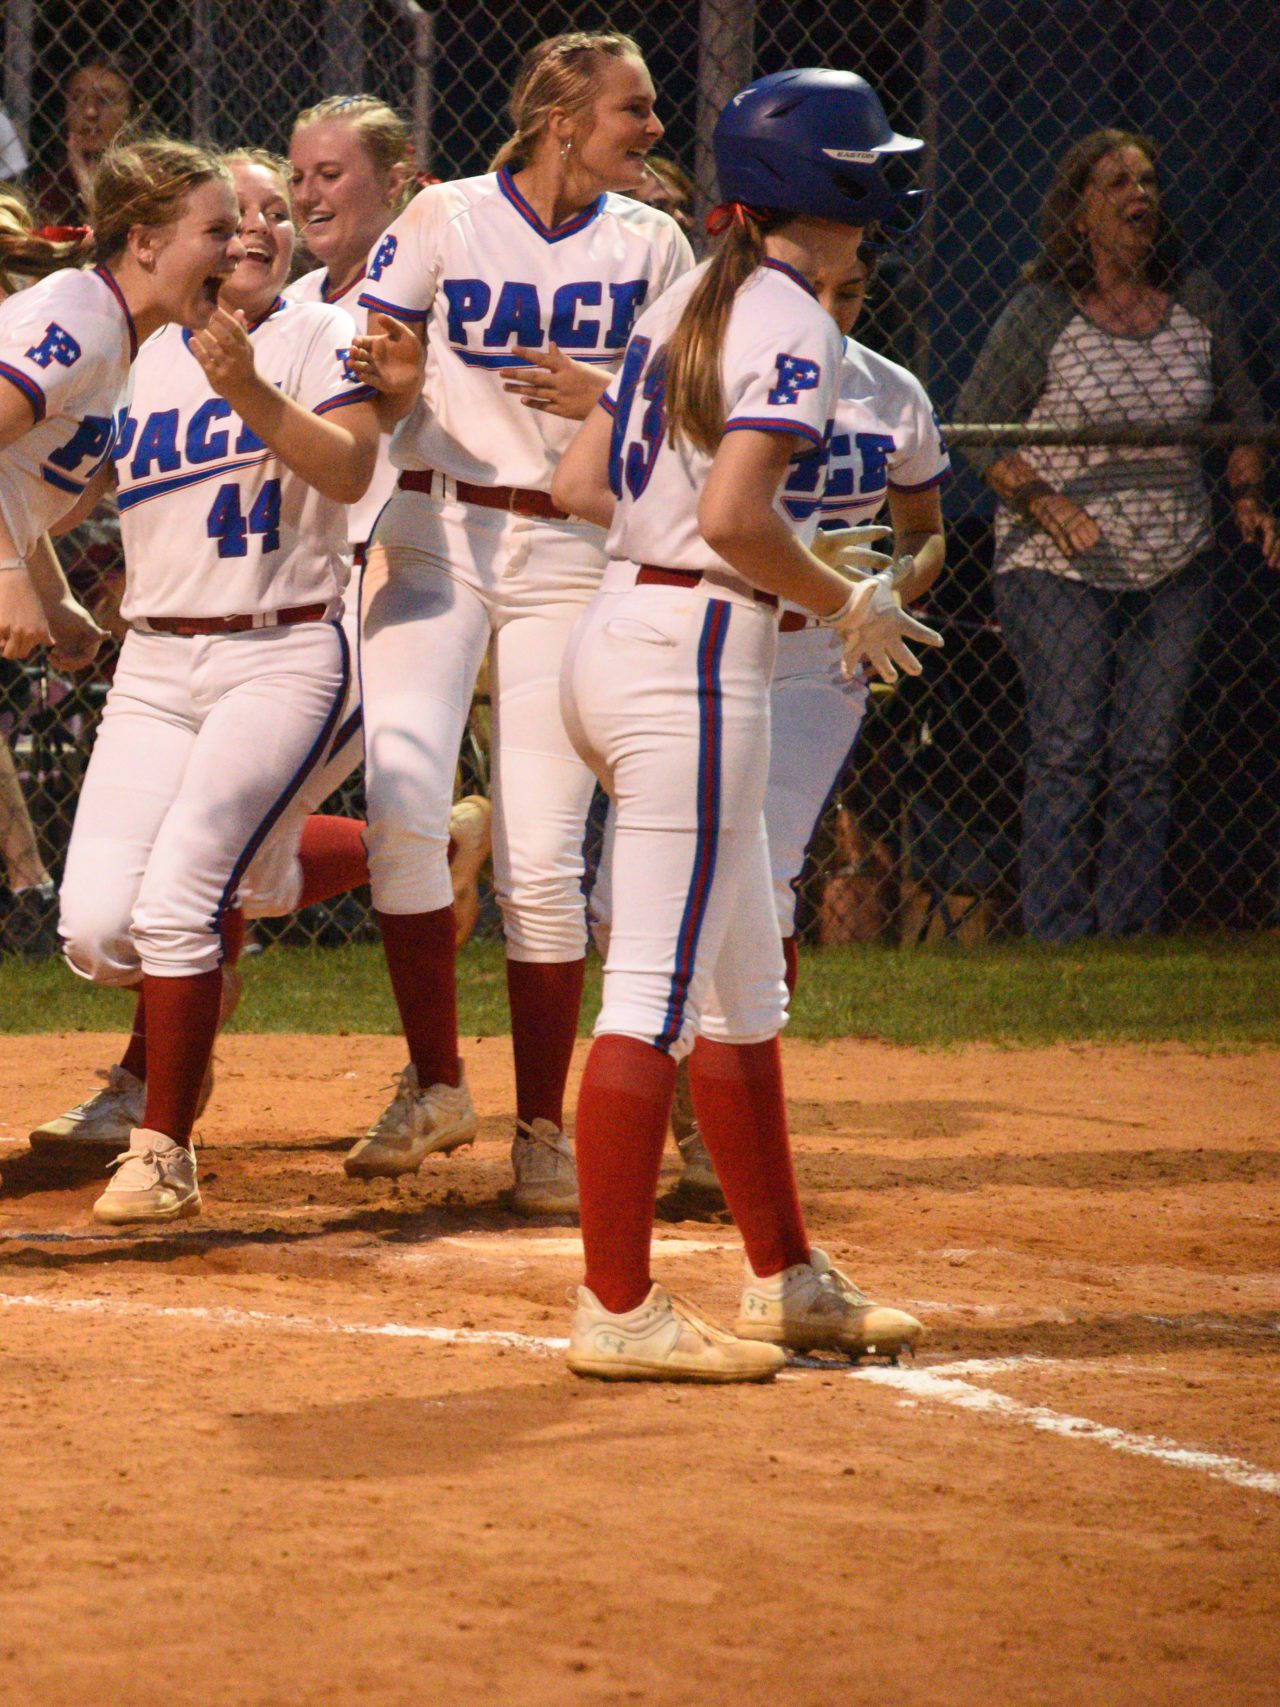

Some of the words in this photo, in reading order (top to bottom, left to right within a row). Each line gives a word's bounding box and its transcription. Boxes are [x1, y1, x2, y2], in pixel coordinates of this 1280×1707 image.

[443, 278, 650, 349] PACE
[24, 321, 82, 369] P
[767, 353, 821, 405] P
[207, 478, 282, 559] 44
